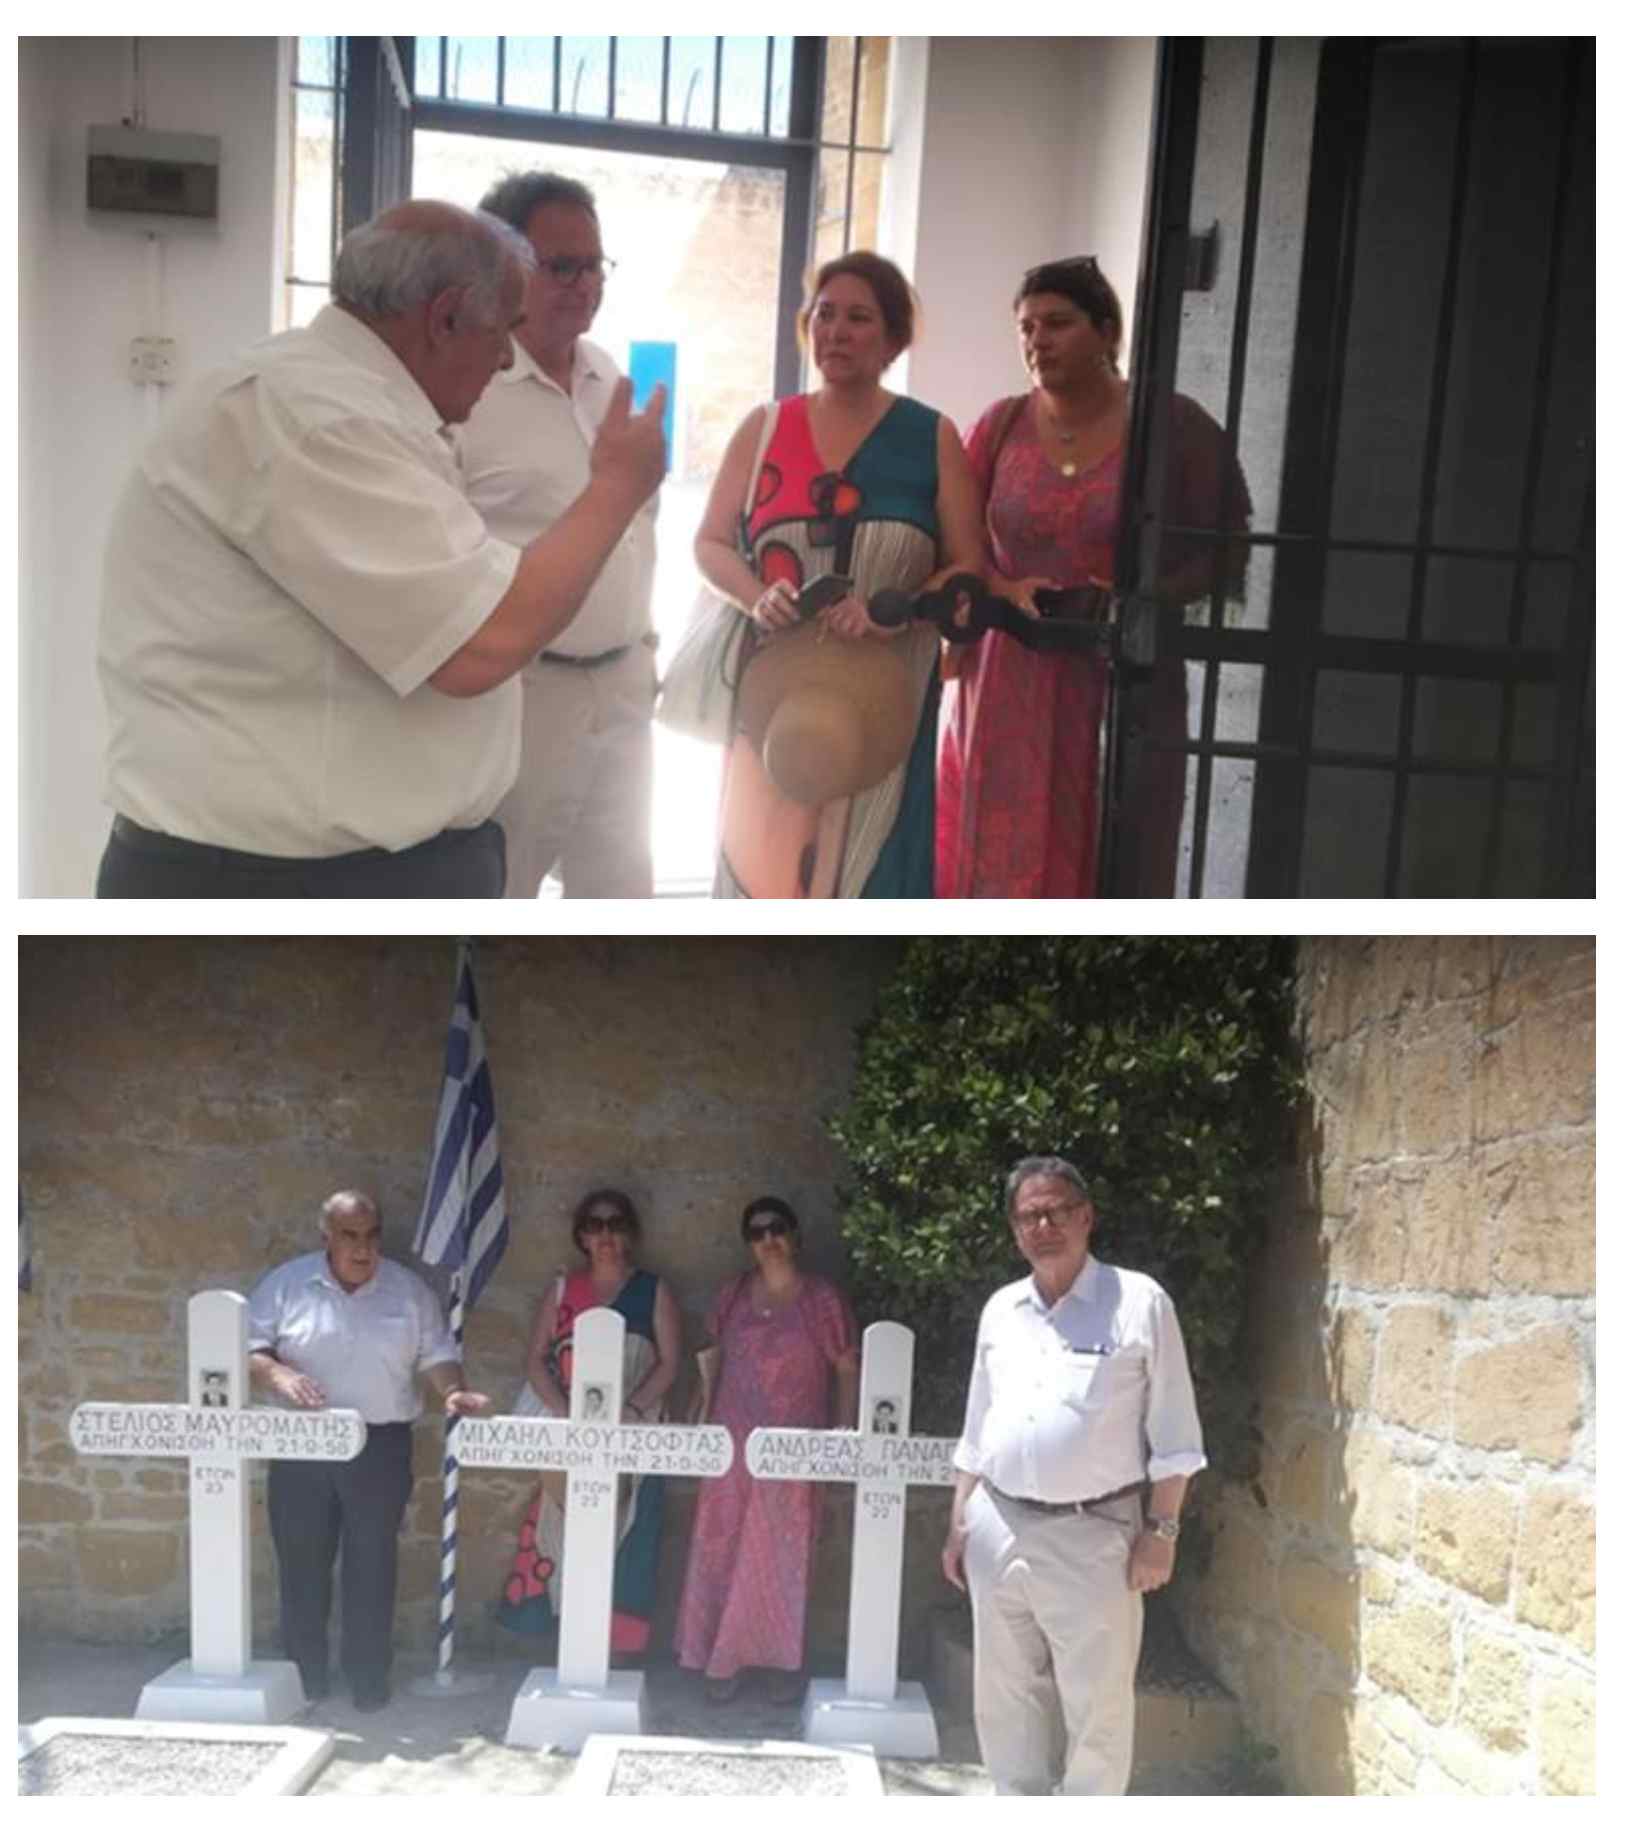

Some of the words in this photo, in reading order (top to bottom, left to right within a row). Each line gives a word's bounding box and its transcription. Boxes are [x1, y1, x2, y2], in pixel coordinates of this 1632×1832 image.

[76, 1410, 178, 1434] ΣΤΕΛΙΟΣ
[185, 1412, 352, 1439] ΜΑΥΡΟΜΑΤΗΣ
[227, 1435, 263, 1453] ΤΗΝ
[458, 1421, 553, 1447] ΜΙΧΑΗΛ
[566, 1424, 726, 1455] ΚΟΥΤΣΟΦΤΑΣ
[759, 1434, 865, 1462] ΑΝΔΡΕΑΣ
[881, 1438, 958, 1463] ΠΑΝΑΓ
[603, 1451, 639, 1468] ΤΗΝ
[897, 1462, 933, 1481] ΤΗΝ
